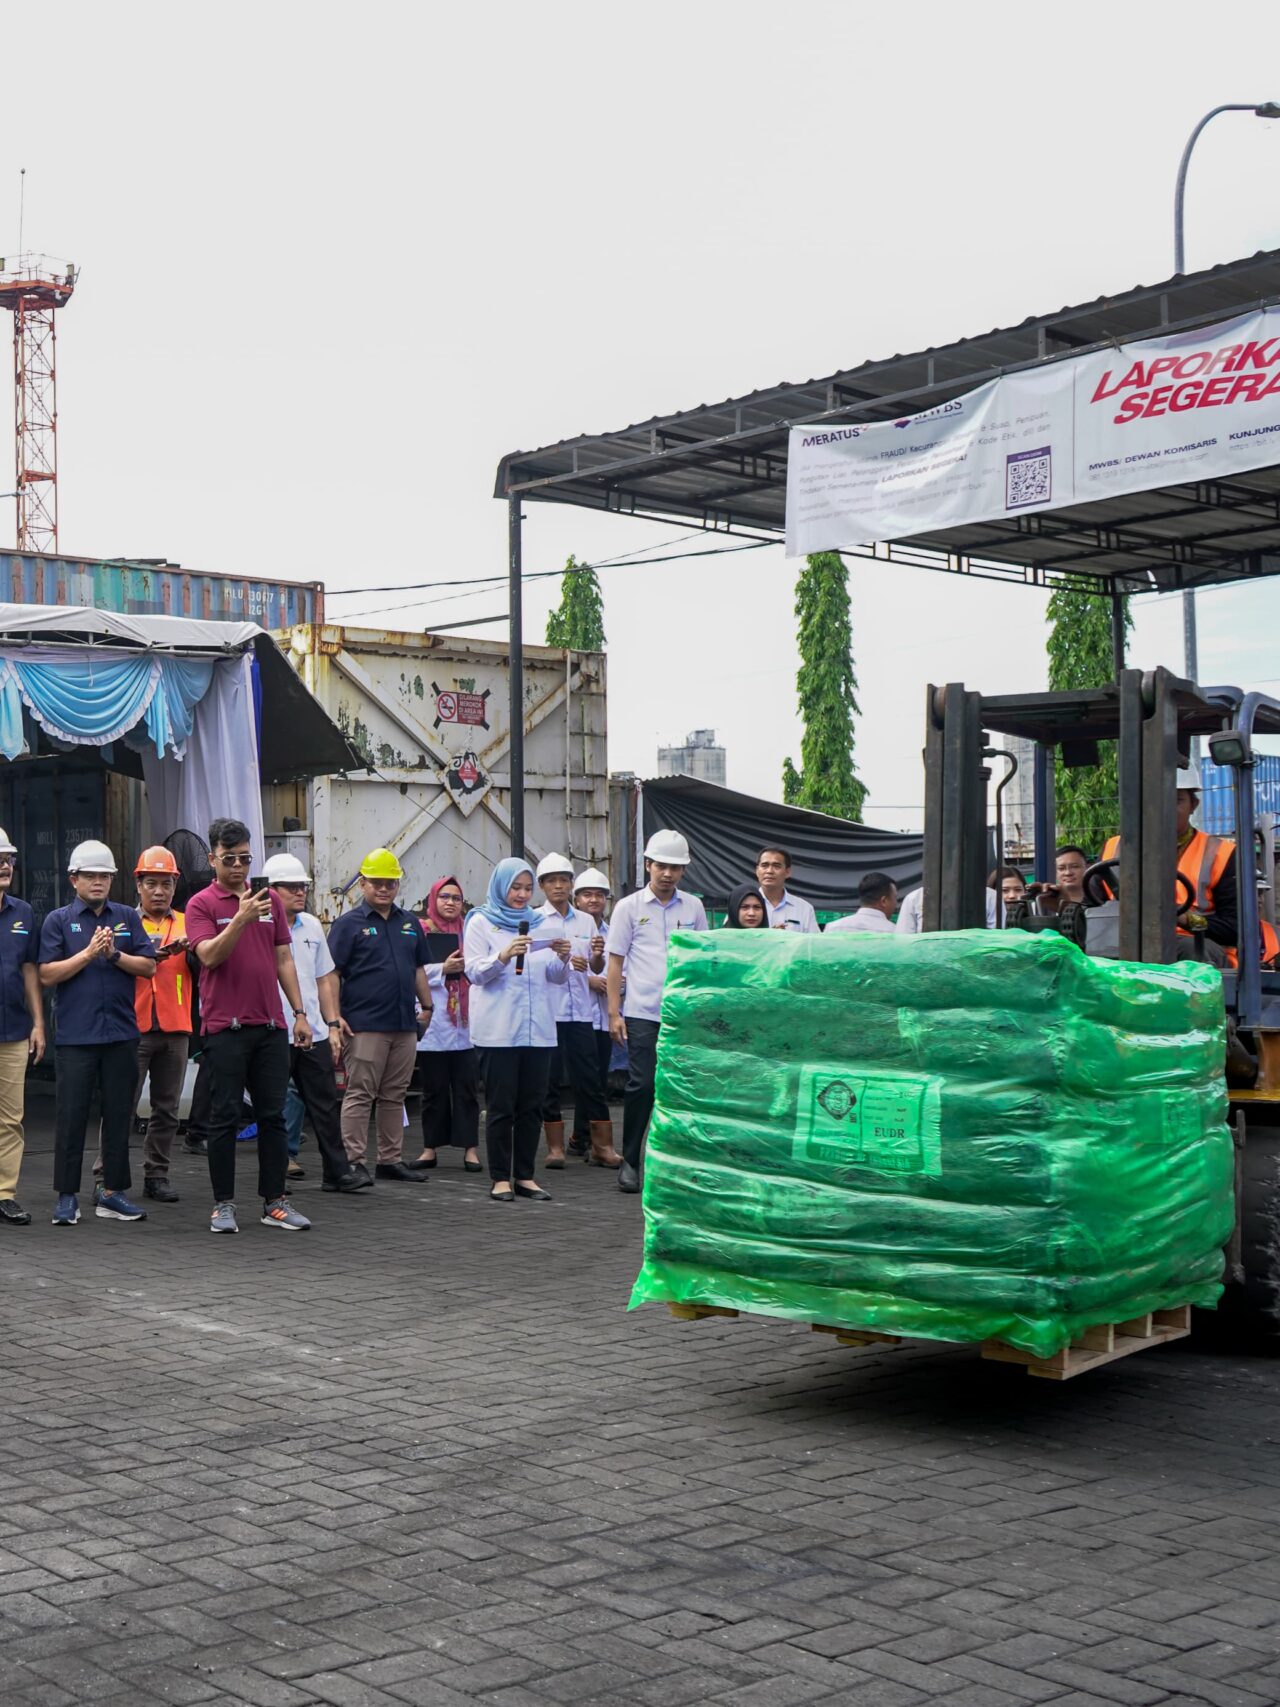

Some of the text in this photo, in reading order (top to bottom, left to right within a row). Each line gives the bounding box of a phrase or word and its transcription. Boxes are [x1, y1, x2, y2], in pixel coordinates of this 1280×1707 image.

[802, 427, 860, 447] MERATUS
[1125, 450, 1161, 464] DEWAN
[1164, 437, 1218, 456] KOMISARIS
[874, 1126, 905, 1138] EUDR
